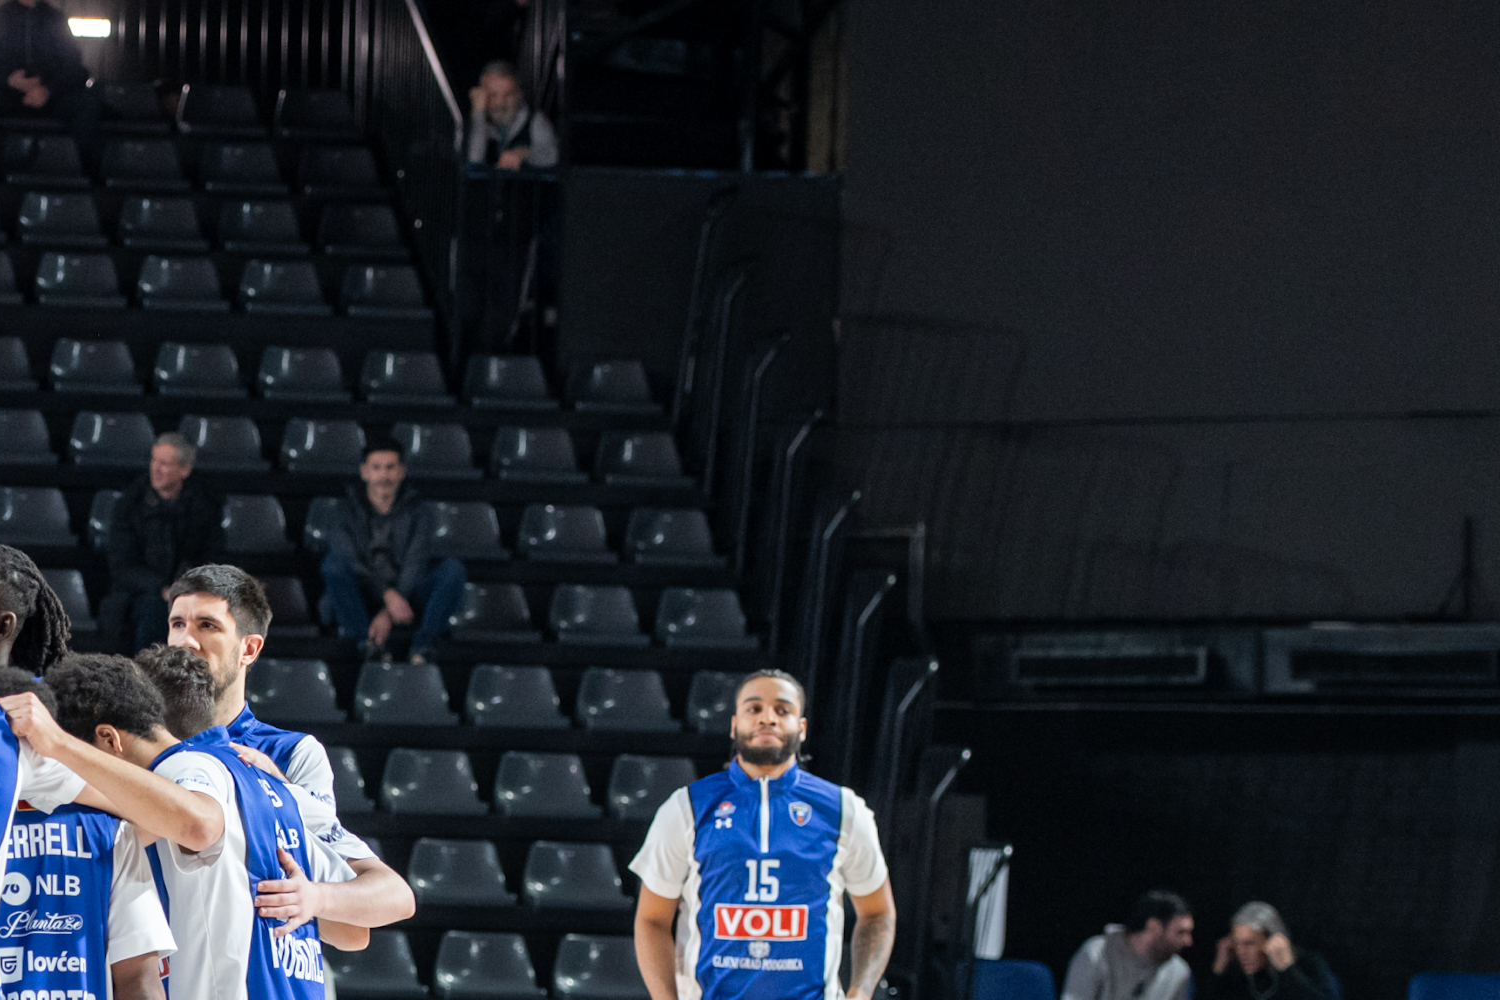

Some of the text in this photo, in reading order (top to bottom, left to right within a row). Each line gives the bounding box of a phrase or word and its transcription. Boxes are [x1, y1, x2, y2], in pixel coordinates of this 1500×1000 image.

[35, 874, 81, 897] NLB
[744, 858, 781, 902] 15
[720, 908, 800, 937] VOLI
